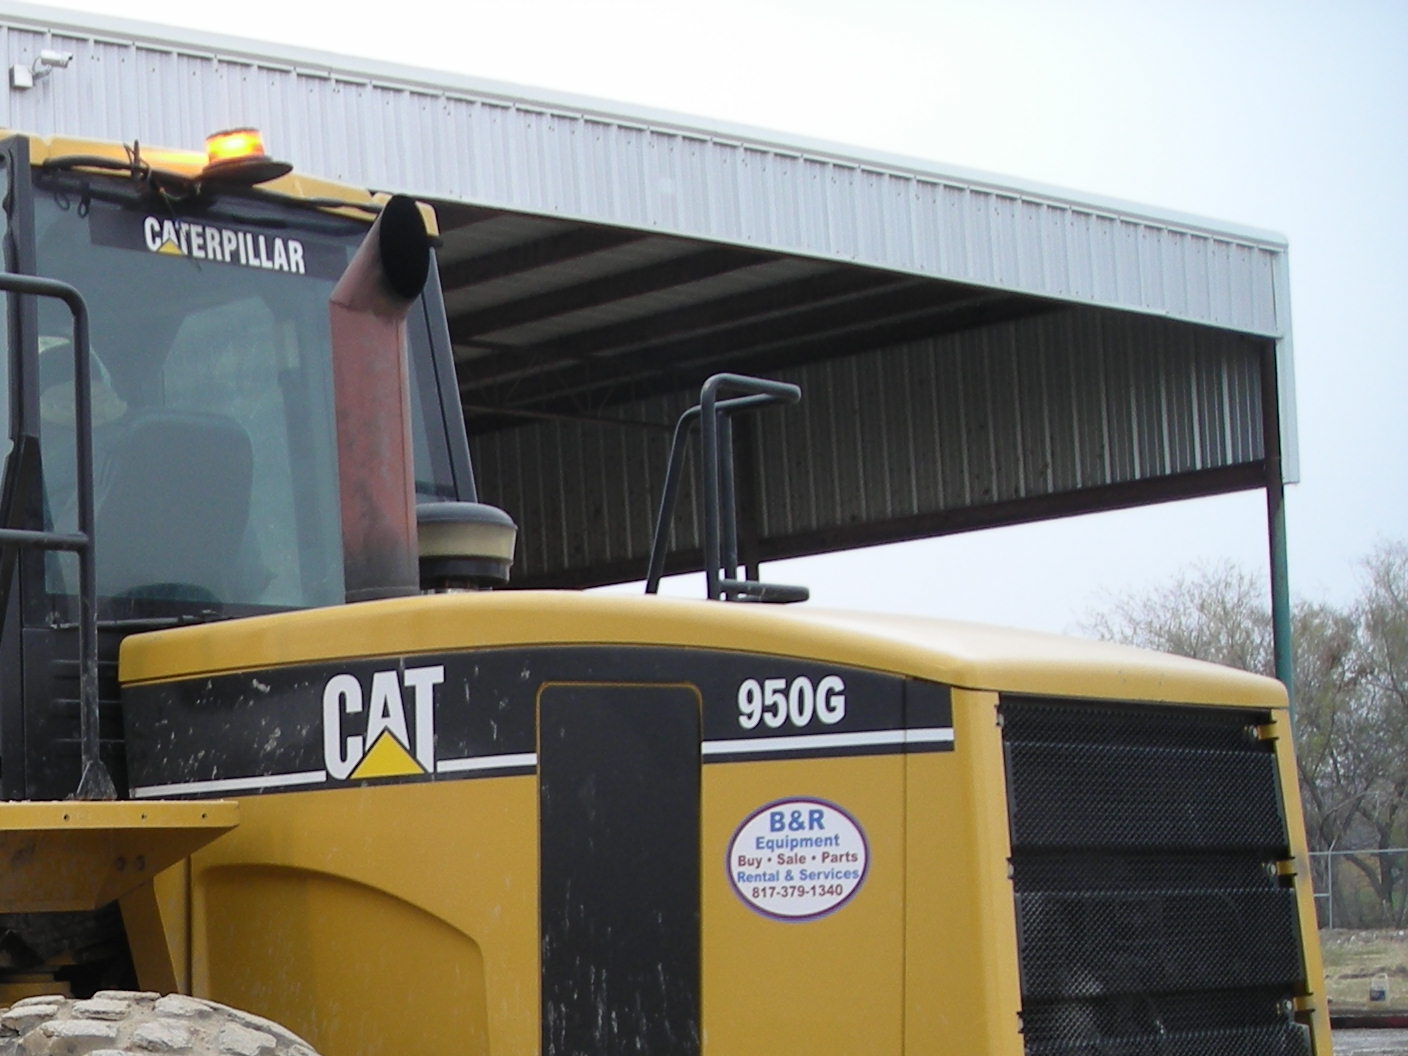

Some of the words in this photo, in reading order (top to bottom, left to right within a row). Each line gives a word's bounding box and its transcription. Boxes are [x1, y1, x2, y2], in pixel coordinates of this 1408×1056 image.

[143, 215, 306, 275] CATERPILLAR
[737, 674, 846, 730] 950G
[322, 664, 445, 781] CAT
[769, 808, 826, 833] B&R
[755, 833, 841, 852] Equipment
[737, 855, 763, 869] Buy
[776, 853, 807, 866] Sale
[821, 851, 859, 864] Parts
[737, 870, 780, 884] Rental
[784, 869, 795, 882] &
[799, 867, 860, 882] Services
[751, 883, 844, 899] 817-379-1340
